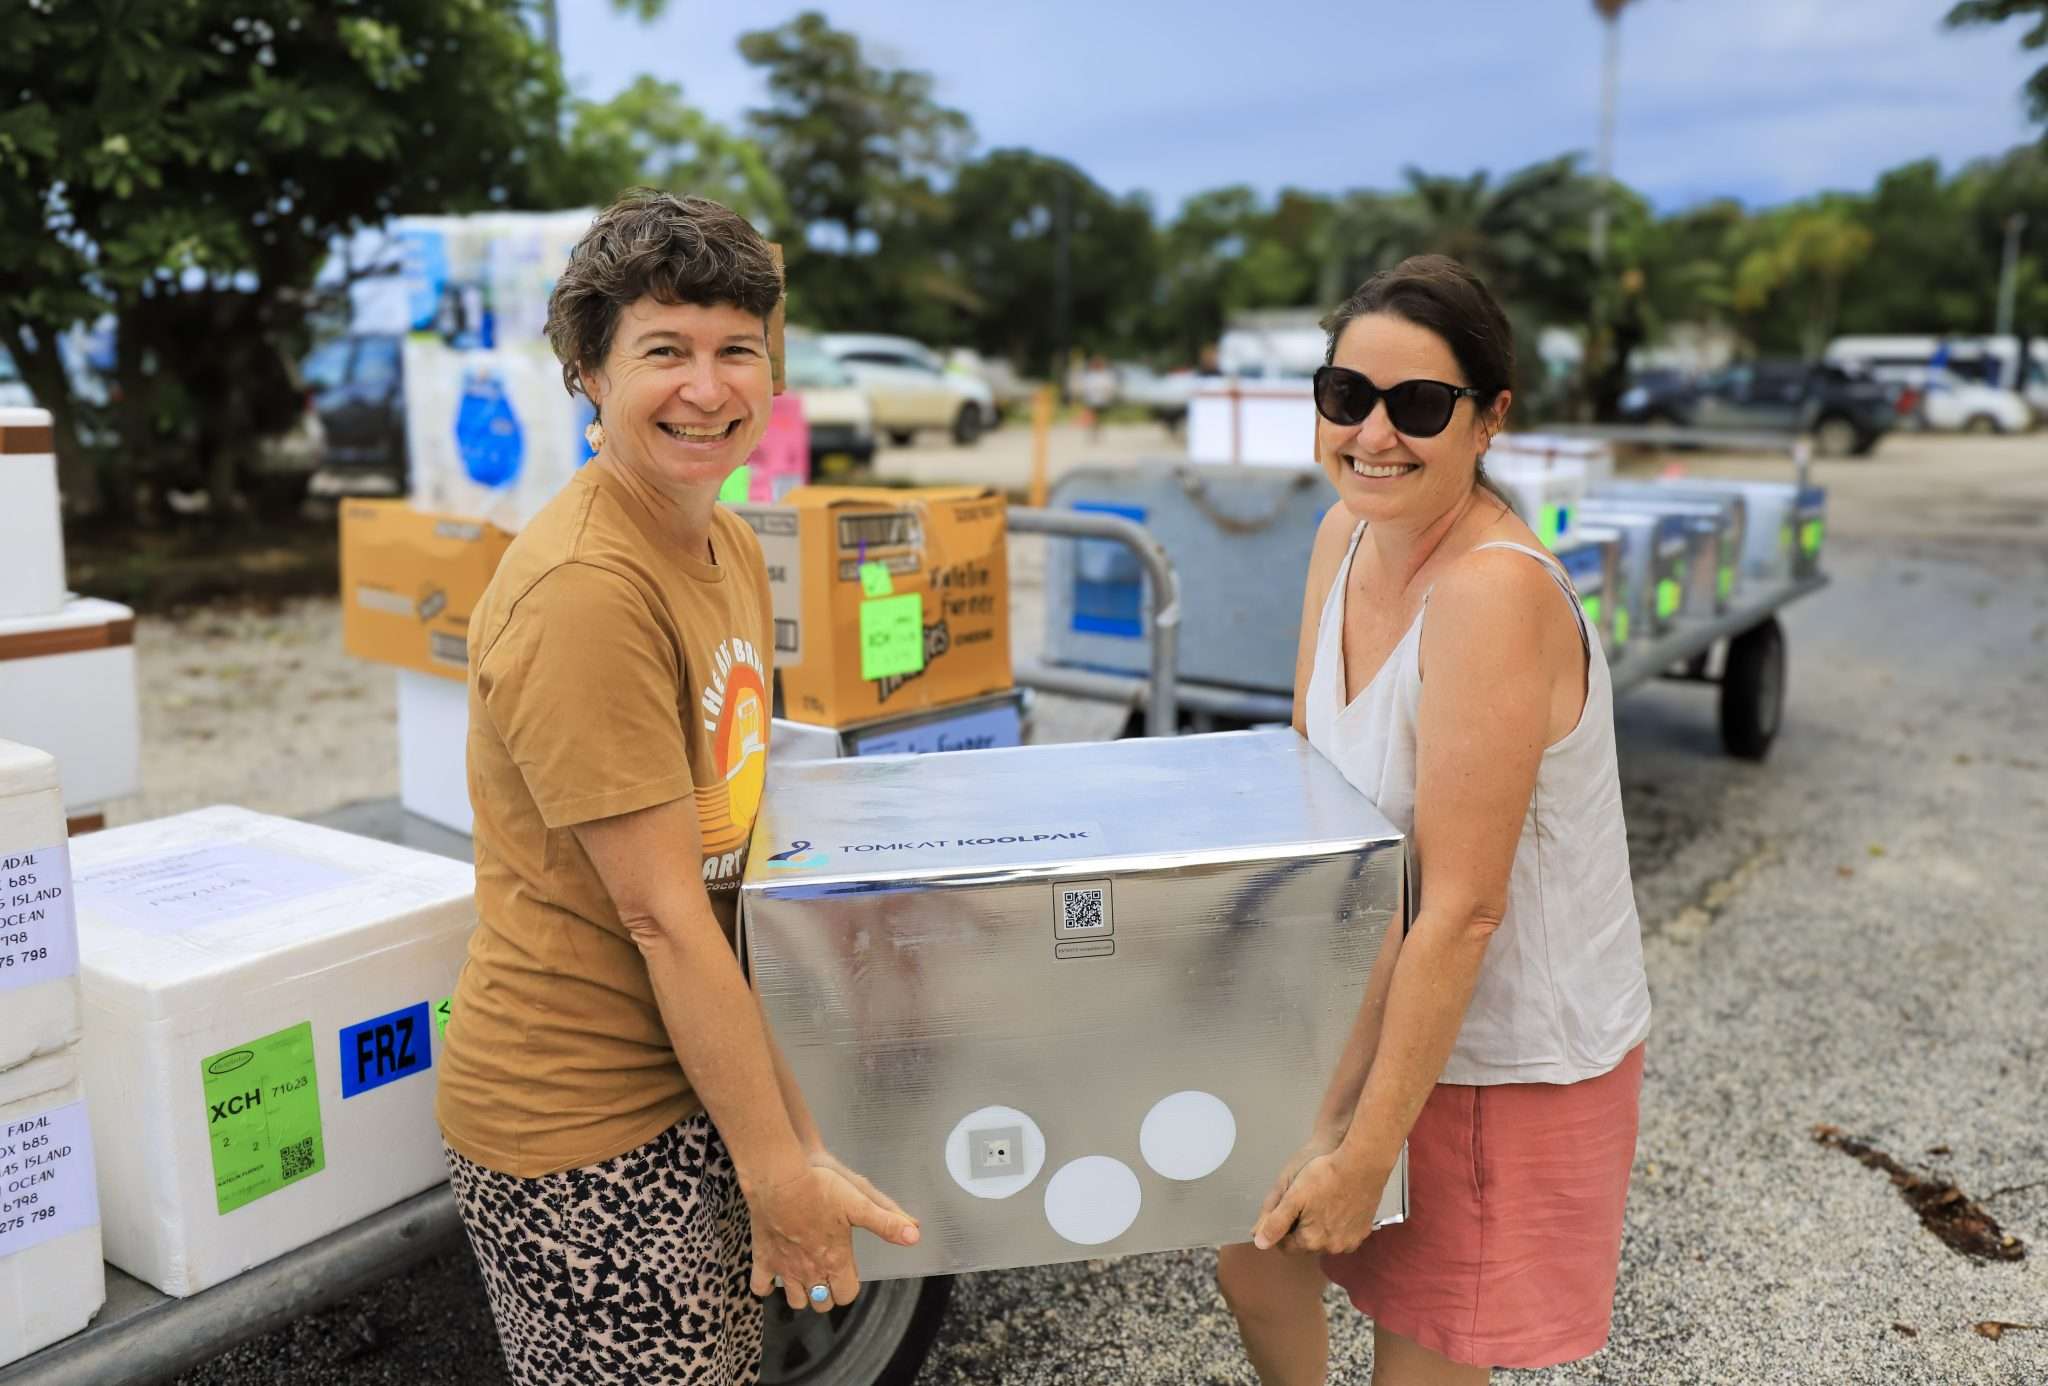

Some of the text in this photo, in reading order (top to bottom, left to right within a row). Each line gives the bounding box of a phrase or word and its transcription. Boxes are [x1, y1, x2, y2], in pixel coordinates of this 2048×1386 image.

[839, 831, 1088, 852] TOMKAT KOOLPAK
[1, 854, 38, 871] ADAL
[702, 847, 743, 880] ART
[12, 887, 62, 907] ISLAND
[0, 931, 28, 946] 798
[0, 947, 47, 968] 75 798
[356, 1016, 416, 1084] FRZ
[210, 1088, 261, 1124] XCH
[8, 1116, 51, 1137] FADAL
[0, 1134, 49, 1159] OX 685
[223, 1137, 231, 1147] 2
[25, 1146, 72, 1169] ISLAND
[8, 1168, 55, 1193] OCEAN
[0, 1206, 56, 1234] 275 798
